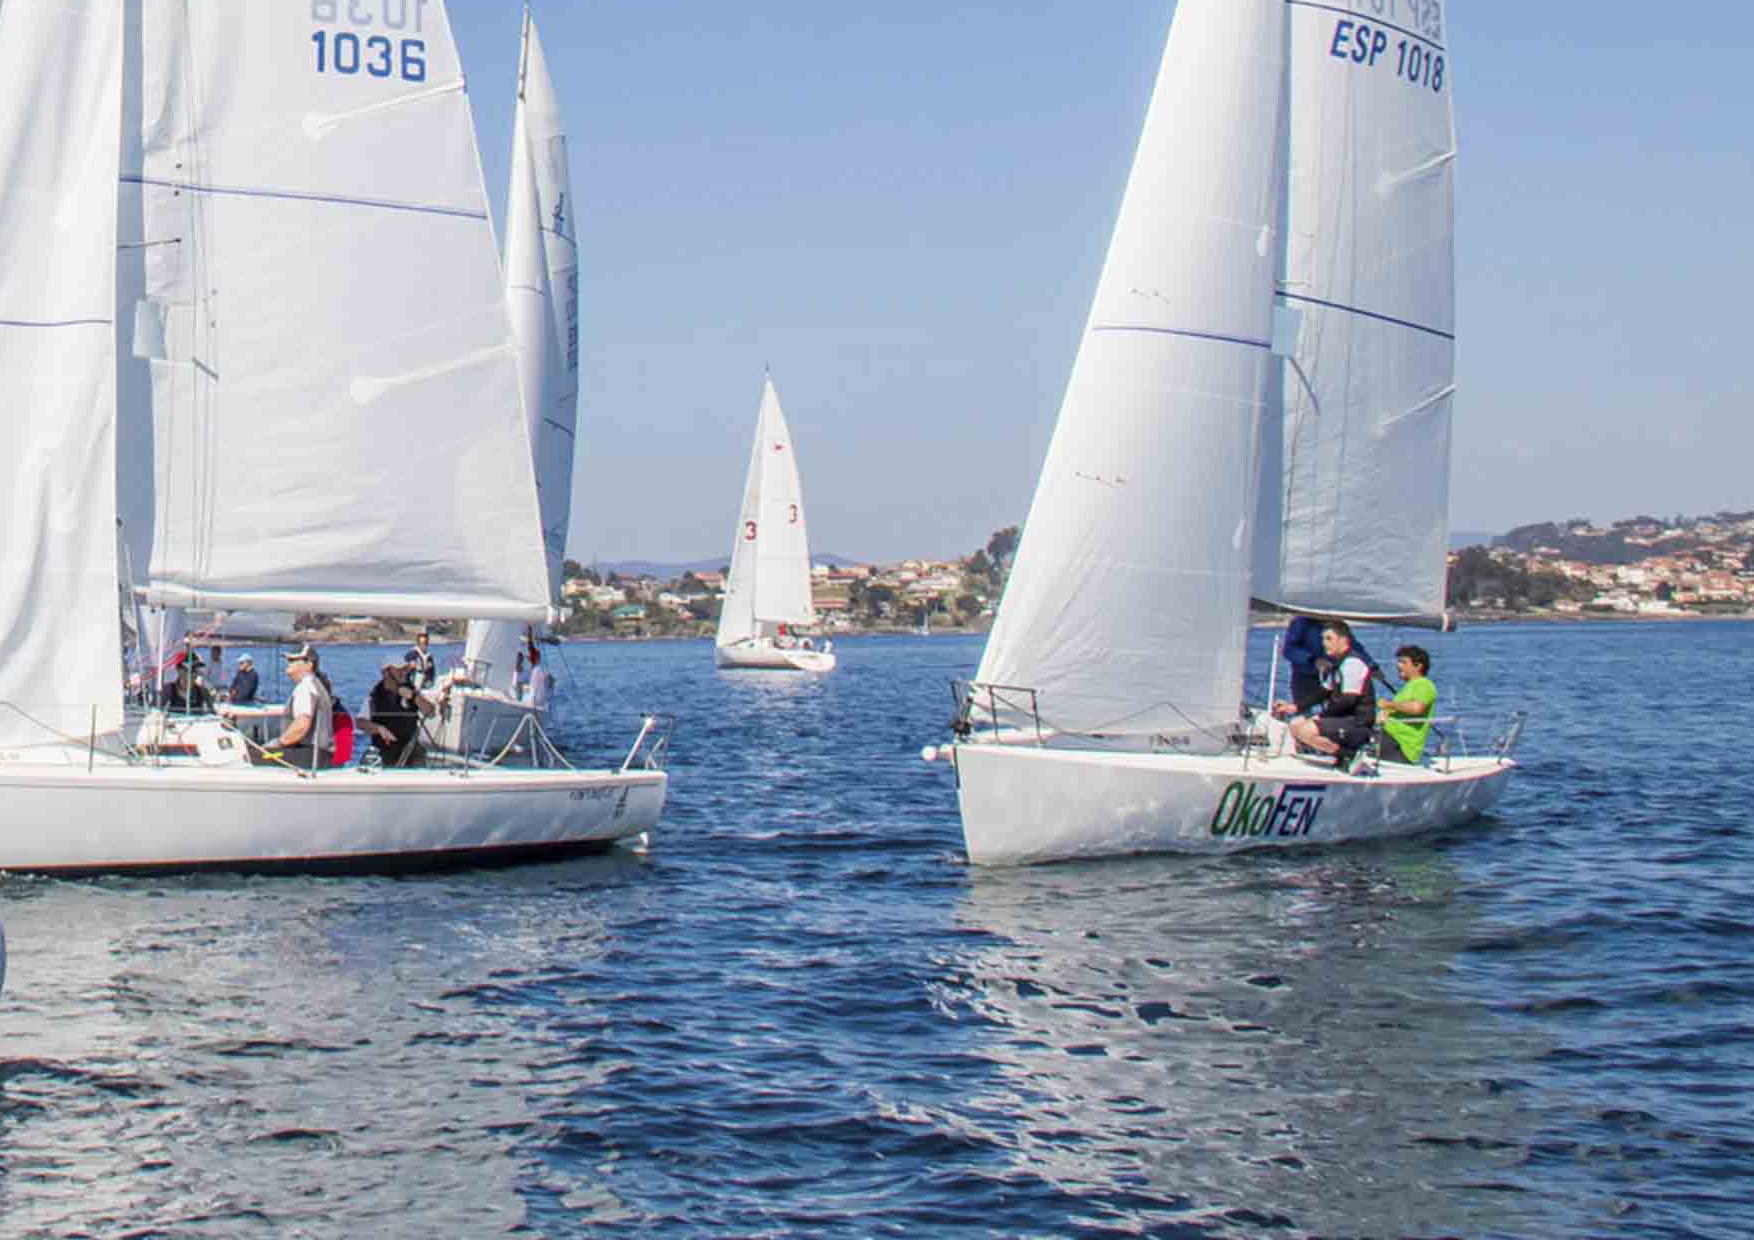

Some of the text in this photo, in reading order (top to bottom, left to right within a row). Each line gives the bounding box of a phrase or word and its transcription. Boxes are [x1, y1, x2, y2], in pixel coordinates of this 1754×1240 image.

[311, 30, 426, 82] 1036
[1330, 20, 1445, 93] ESP 1018
[744, 520, 757, 542] 3
